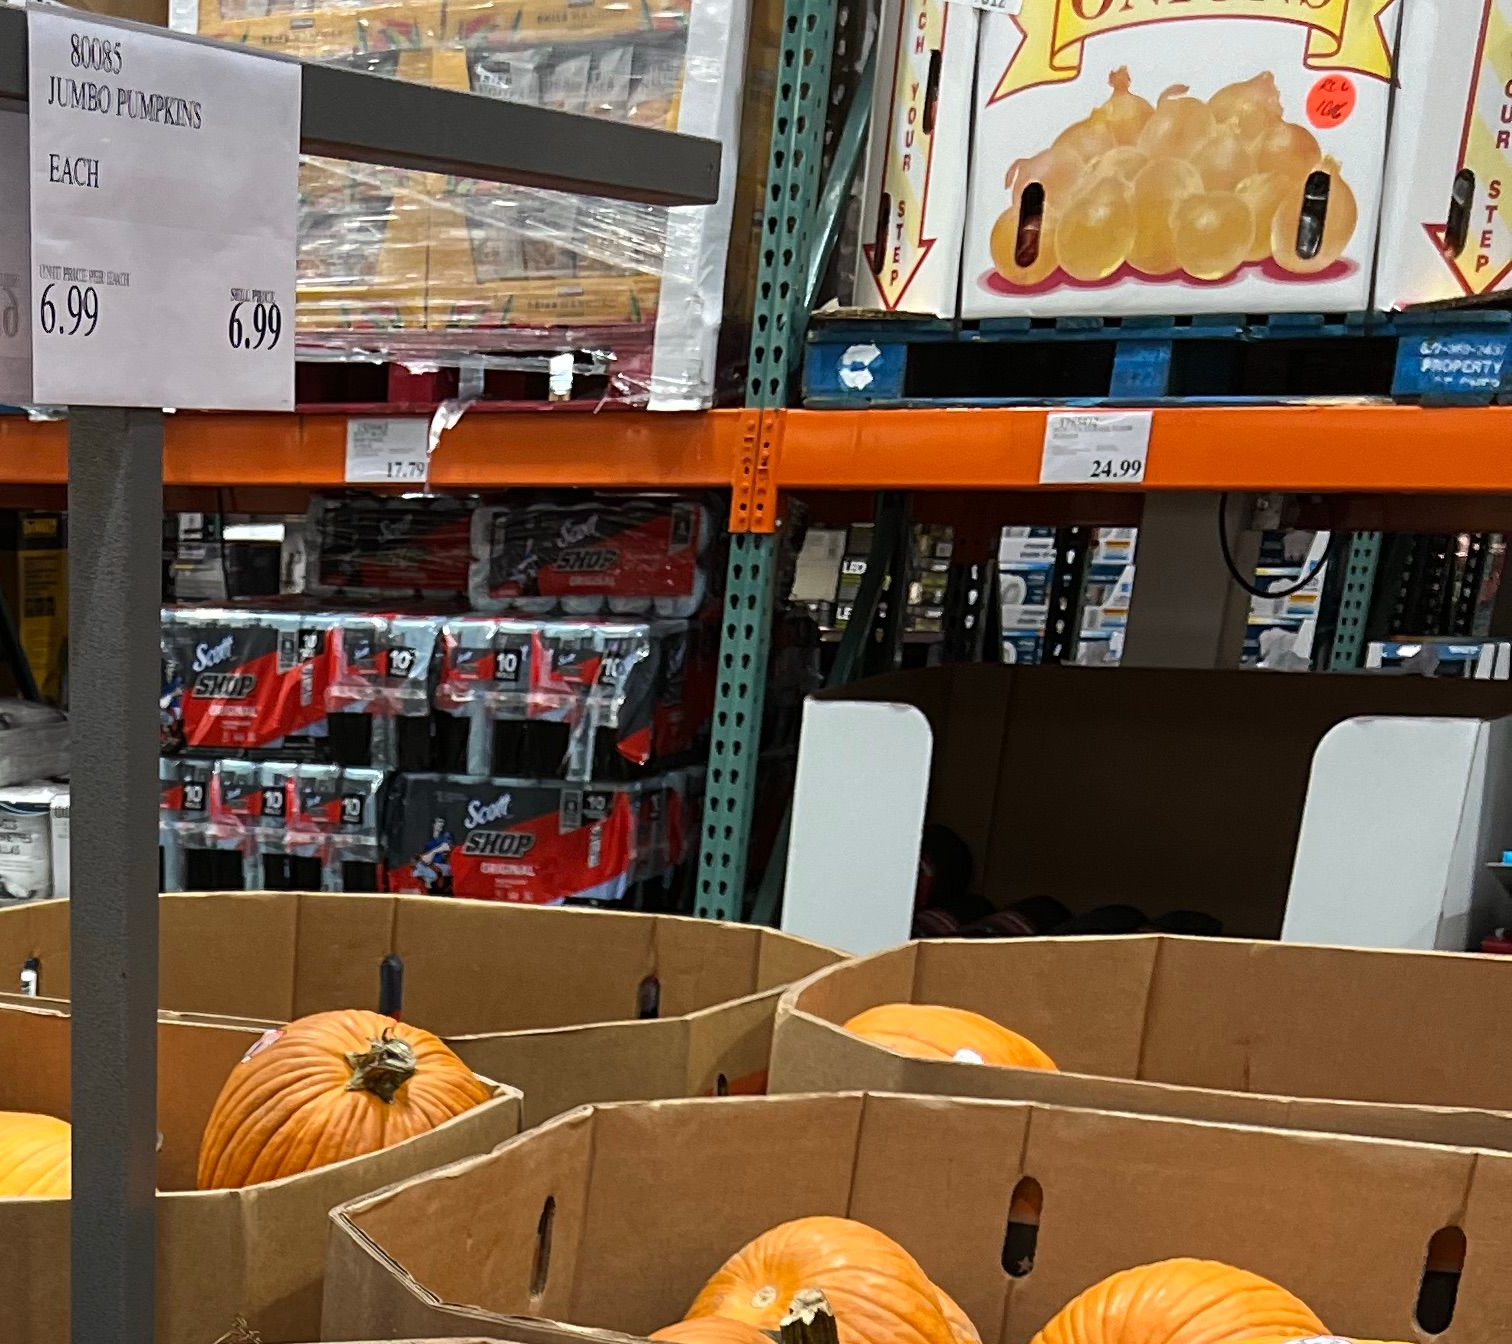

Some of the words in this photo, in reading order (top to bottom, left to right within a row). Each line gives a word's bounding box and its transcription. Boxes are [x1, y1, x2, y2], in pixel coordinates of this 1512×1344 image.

[70, 33, 123, 75] 80085
[48, 76, 111, 114] JUMBO
[116, 87, 202, 130] PUMPKINS
[901, 82, 920, 172] YOUR
[49, 153, 100, 189] EACH
[1475, 180, 1502, 273] STEP
[889, 200, 906, 286] STEP
[39, 264, 61, 281] UNIT
[63, 266, 87, 283] PRICE
[88, 268, 105, 284] PER
[106, 270, 130, 287] EACH
[231, 288, 250, 302] SELL
[252, 289, 276, 305] PRICE
[40, 283, 99, 336] 6.99
[228, 302, 282, 350] 6.99
[387, 461, 426, 478] 17.79
[1090, 459, 1142, 478] 24.99
[555, 549, 620, 571] SHOP
[843, 560, 867, 574] LED
[192, 633, 235, 673] Scott
[390, 650, 414, 669] 10
[496, 653, 518, 672] 10
[195, 673, 256, 697] SHOP
[184, 783, 204, 802] 10
[263, 789, 284, 808] 10
[464, 792, 512, 829] Scott
[465, 832, 535, 857] SHOP
